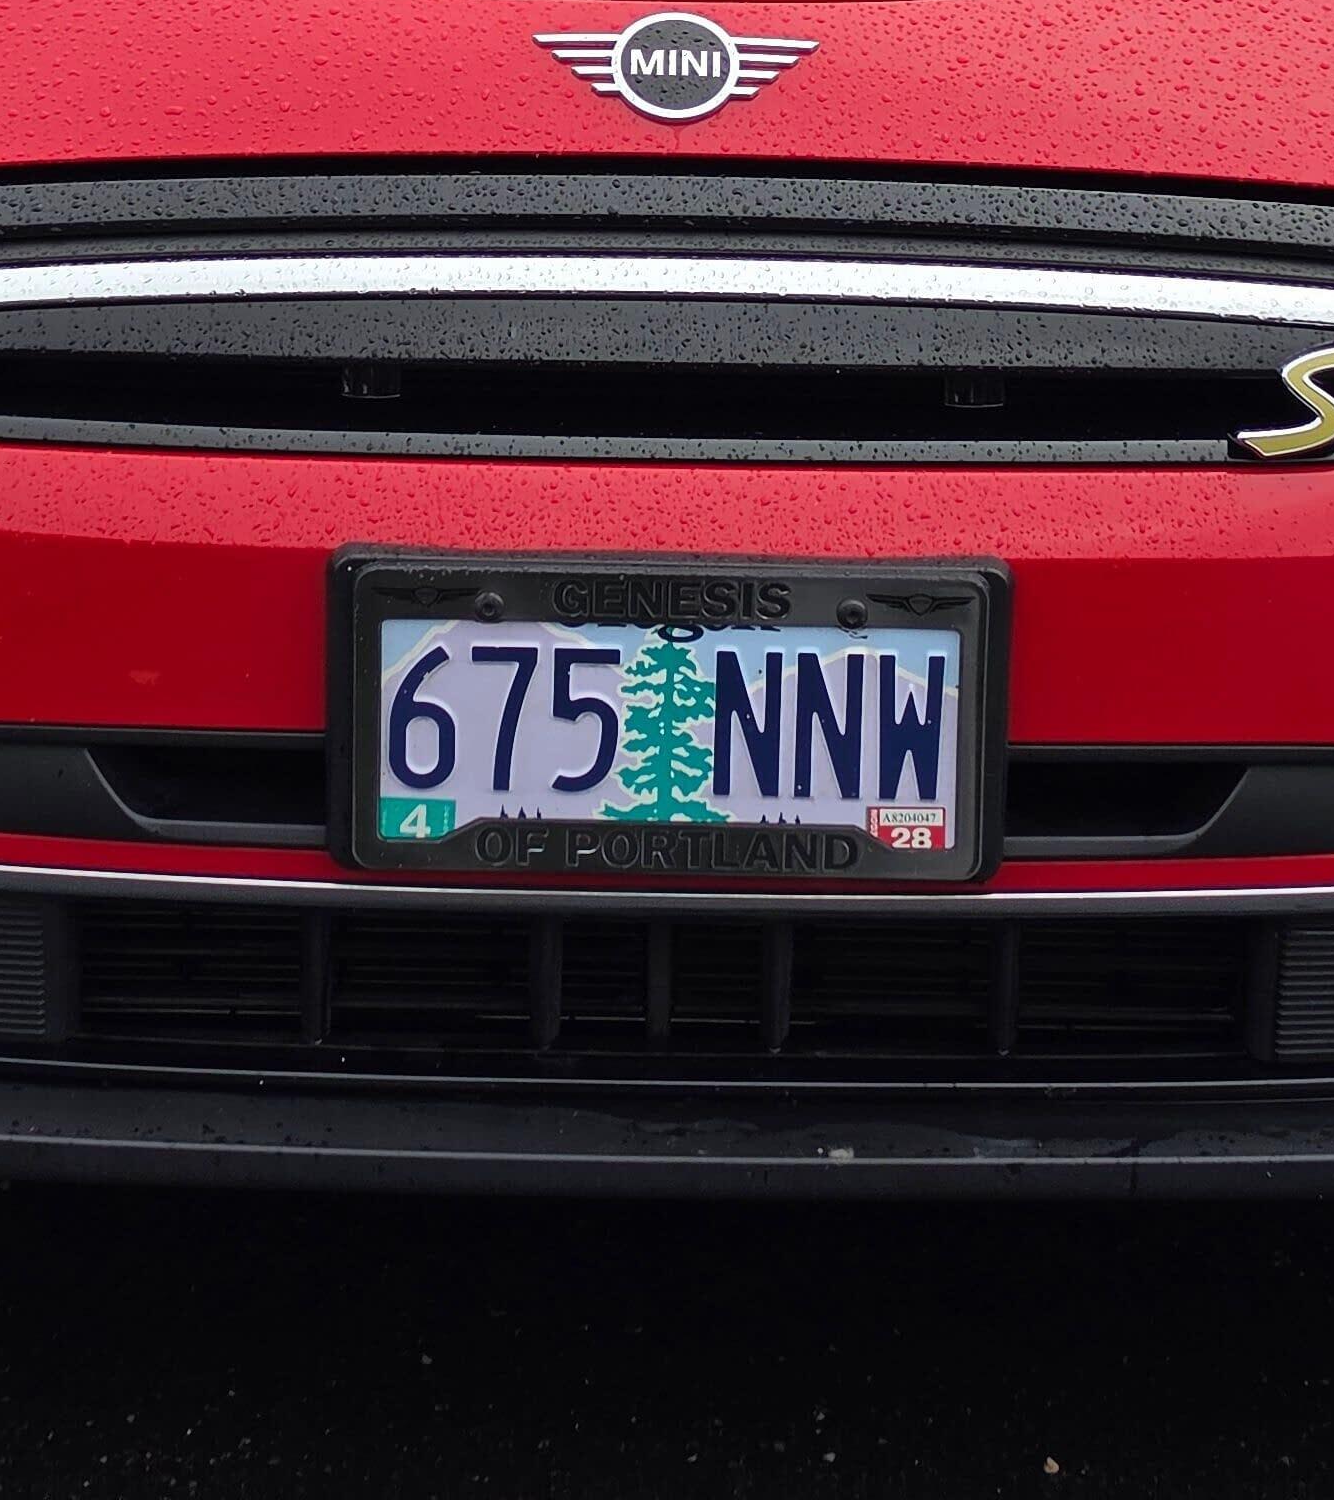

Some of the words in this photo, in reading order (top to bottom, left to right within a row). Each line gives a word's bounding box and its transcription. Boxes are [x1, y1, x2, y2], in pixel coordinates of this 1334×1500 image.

[630, 49, 721, 78] MINI
[552, 578, 792, 621] GENESIS
[387, 646, 622, 792] 675
[712, 650, 946, 801] NNW
[399, 803, 432, 839] 4
[890, 827, 933, 849] 28
[474, 826, 550, 867] OF
[564, 827, 860, 873] PORTLAND
